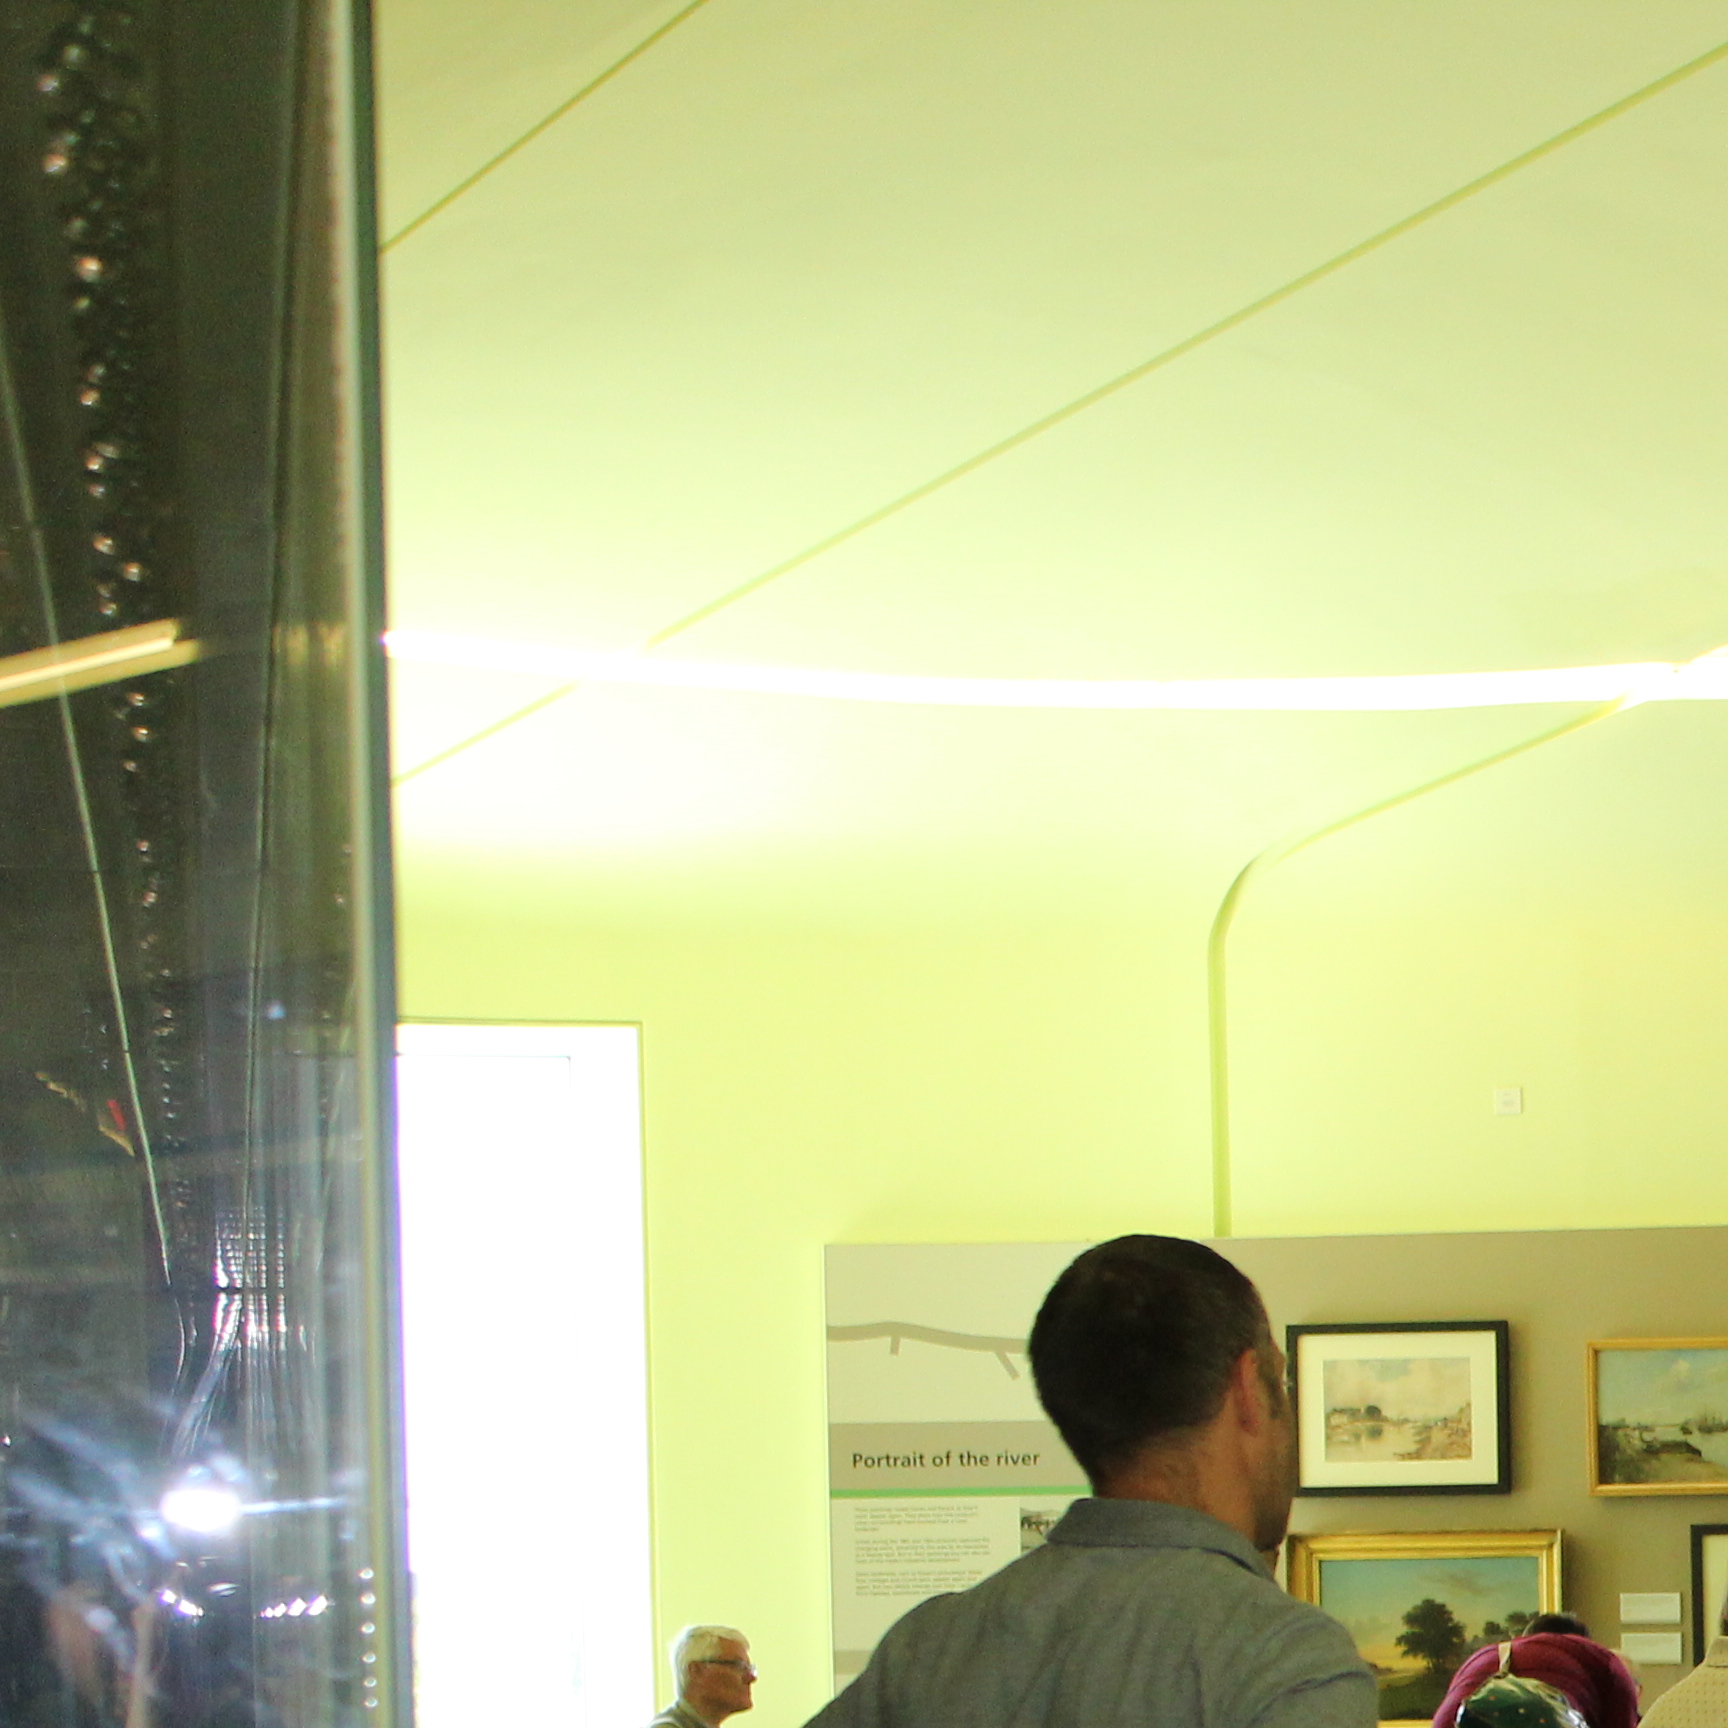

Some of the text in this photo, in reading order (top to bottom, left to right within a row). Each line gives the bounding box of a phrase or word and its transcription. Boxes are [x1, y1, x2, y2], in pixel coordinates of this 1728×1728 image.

[852, 1451, 1041, 1468] Portrait of the river
